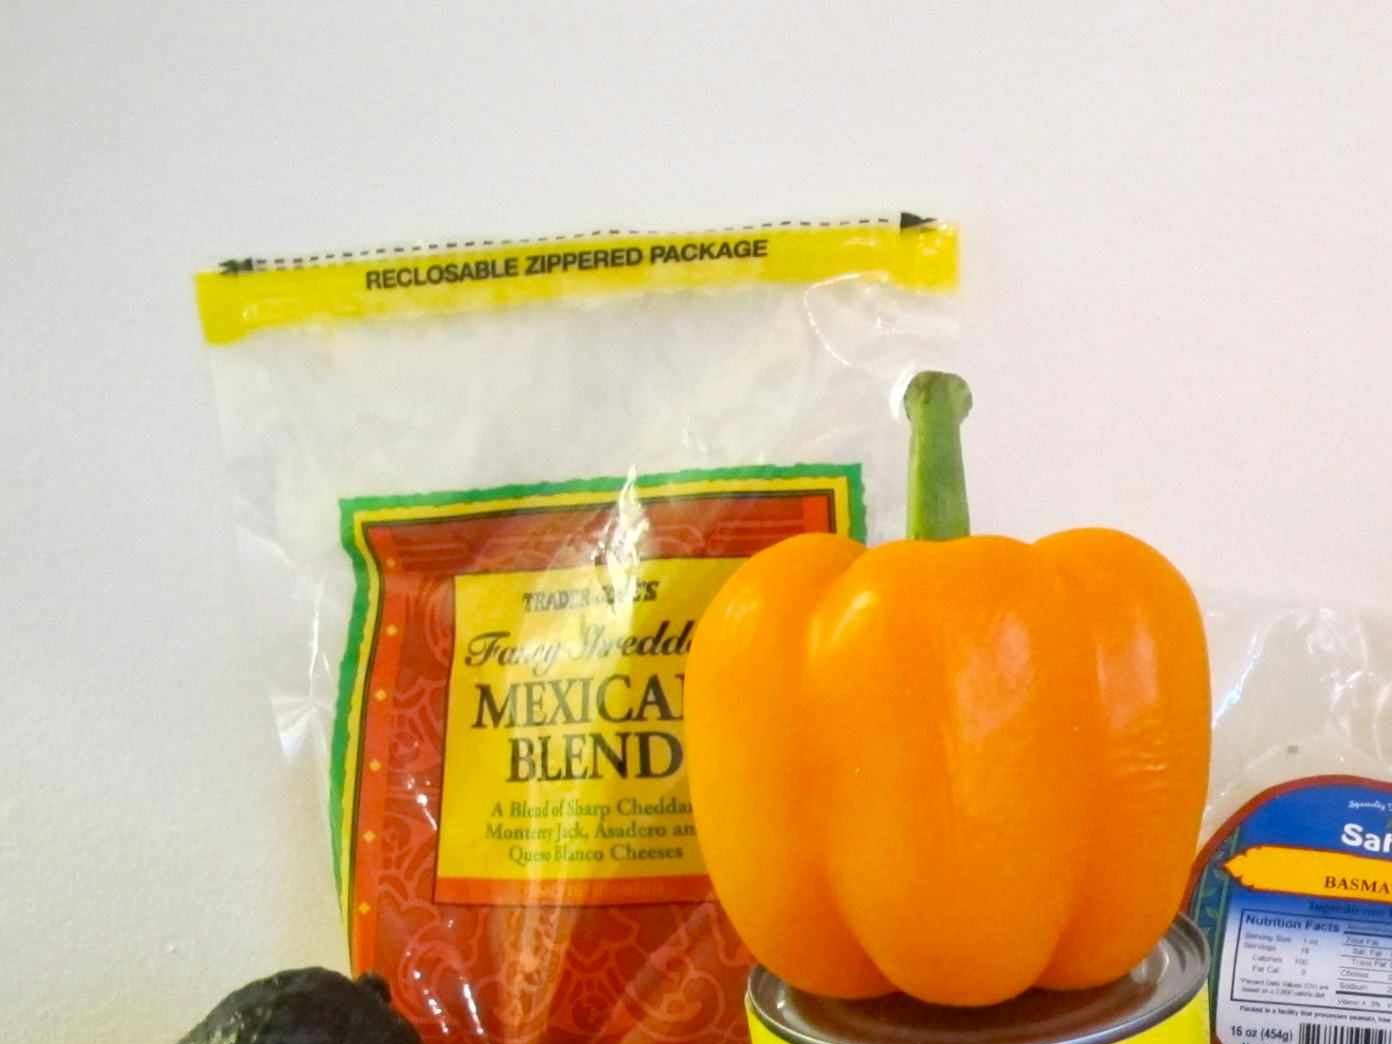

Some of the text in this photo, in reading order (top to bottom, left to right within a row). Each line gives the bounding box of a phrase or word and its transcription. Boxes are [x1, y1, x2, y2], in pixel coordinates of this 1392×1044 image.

[366, 239, 769, 290] RECLOSABLE ZIPPERED PACKAGE
[523, 588, 591, 613] TRADER
[465, 615, 695, 677] Fancy Shredd
[505, 731, 684, 783] BLEND
[491, 801, 504, 817] A
[509, 800, 549, 818] Blend
[567, 798, 611, 820] Sharp
[595, 820, 666, 839] Asadero
[672, 824, 695, 836] an
[554, 845, 603, 862] Blanco
[610, 843, 683, 861] Cheeses
[1246, 914, 1302, 930] Nutrition
[1305, 920, 1341, 933] Facts
[1231, 1025, 1293, 1043] 16 oz (454g)
